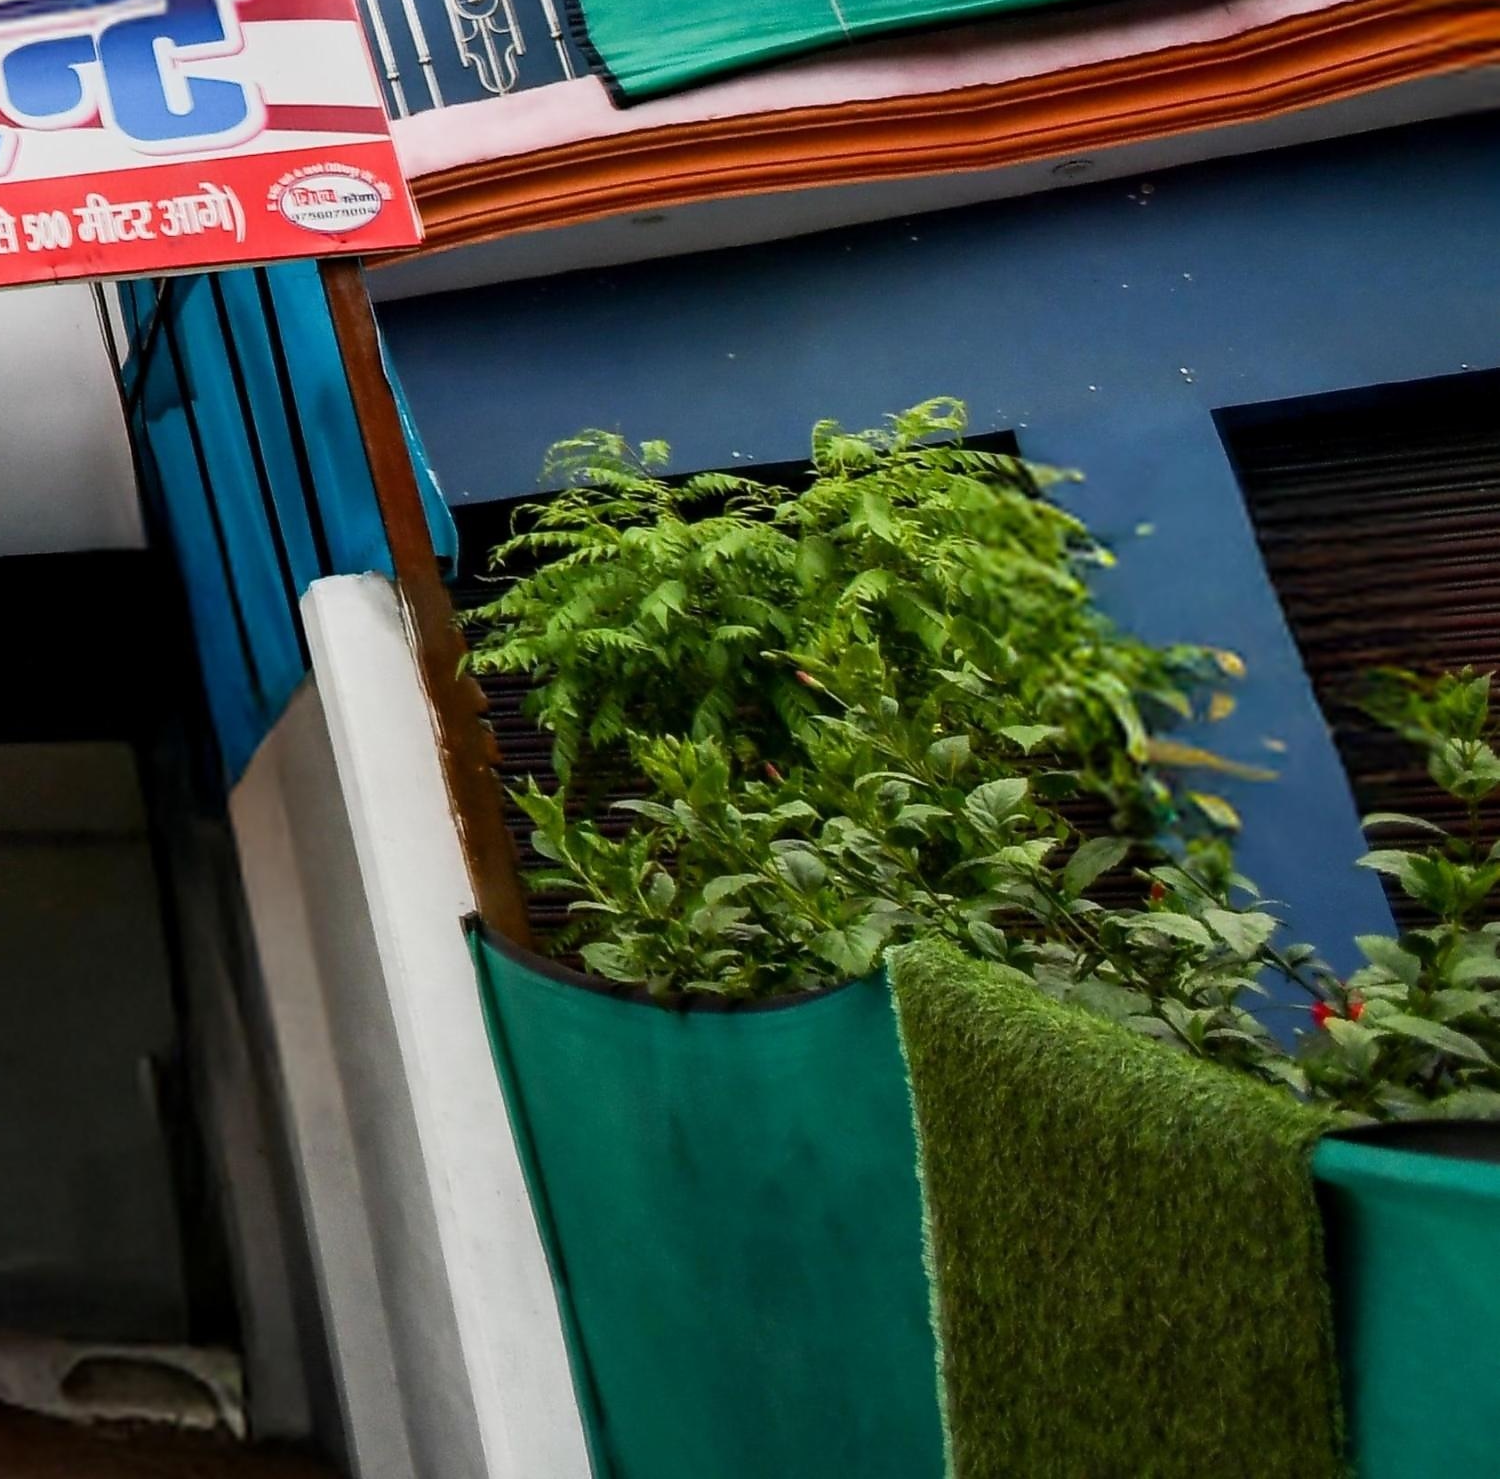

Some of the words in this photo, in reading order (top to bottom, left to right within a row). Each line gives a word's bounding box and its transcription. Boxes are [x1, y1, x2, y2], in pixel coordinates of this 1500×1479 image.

[21, 209, 73, 252] 500
[73, 192, 158, 245] मीटर
[157, 181, 246, 243] आगे)
